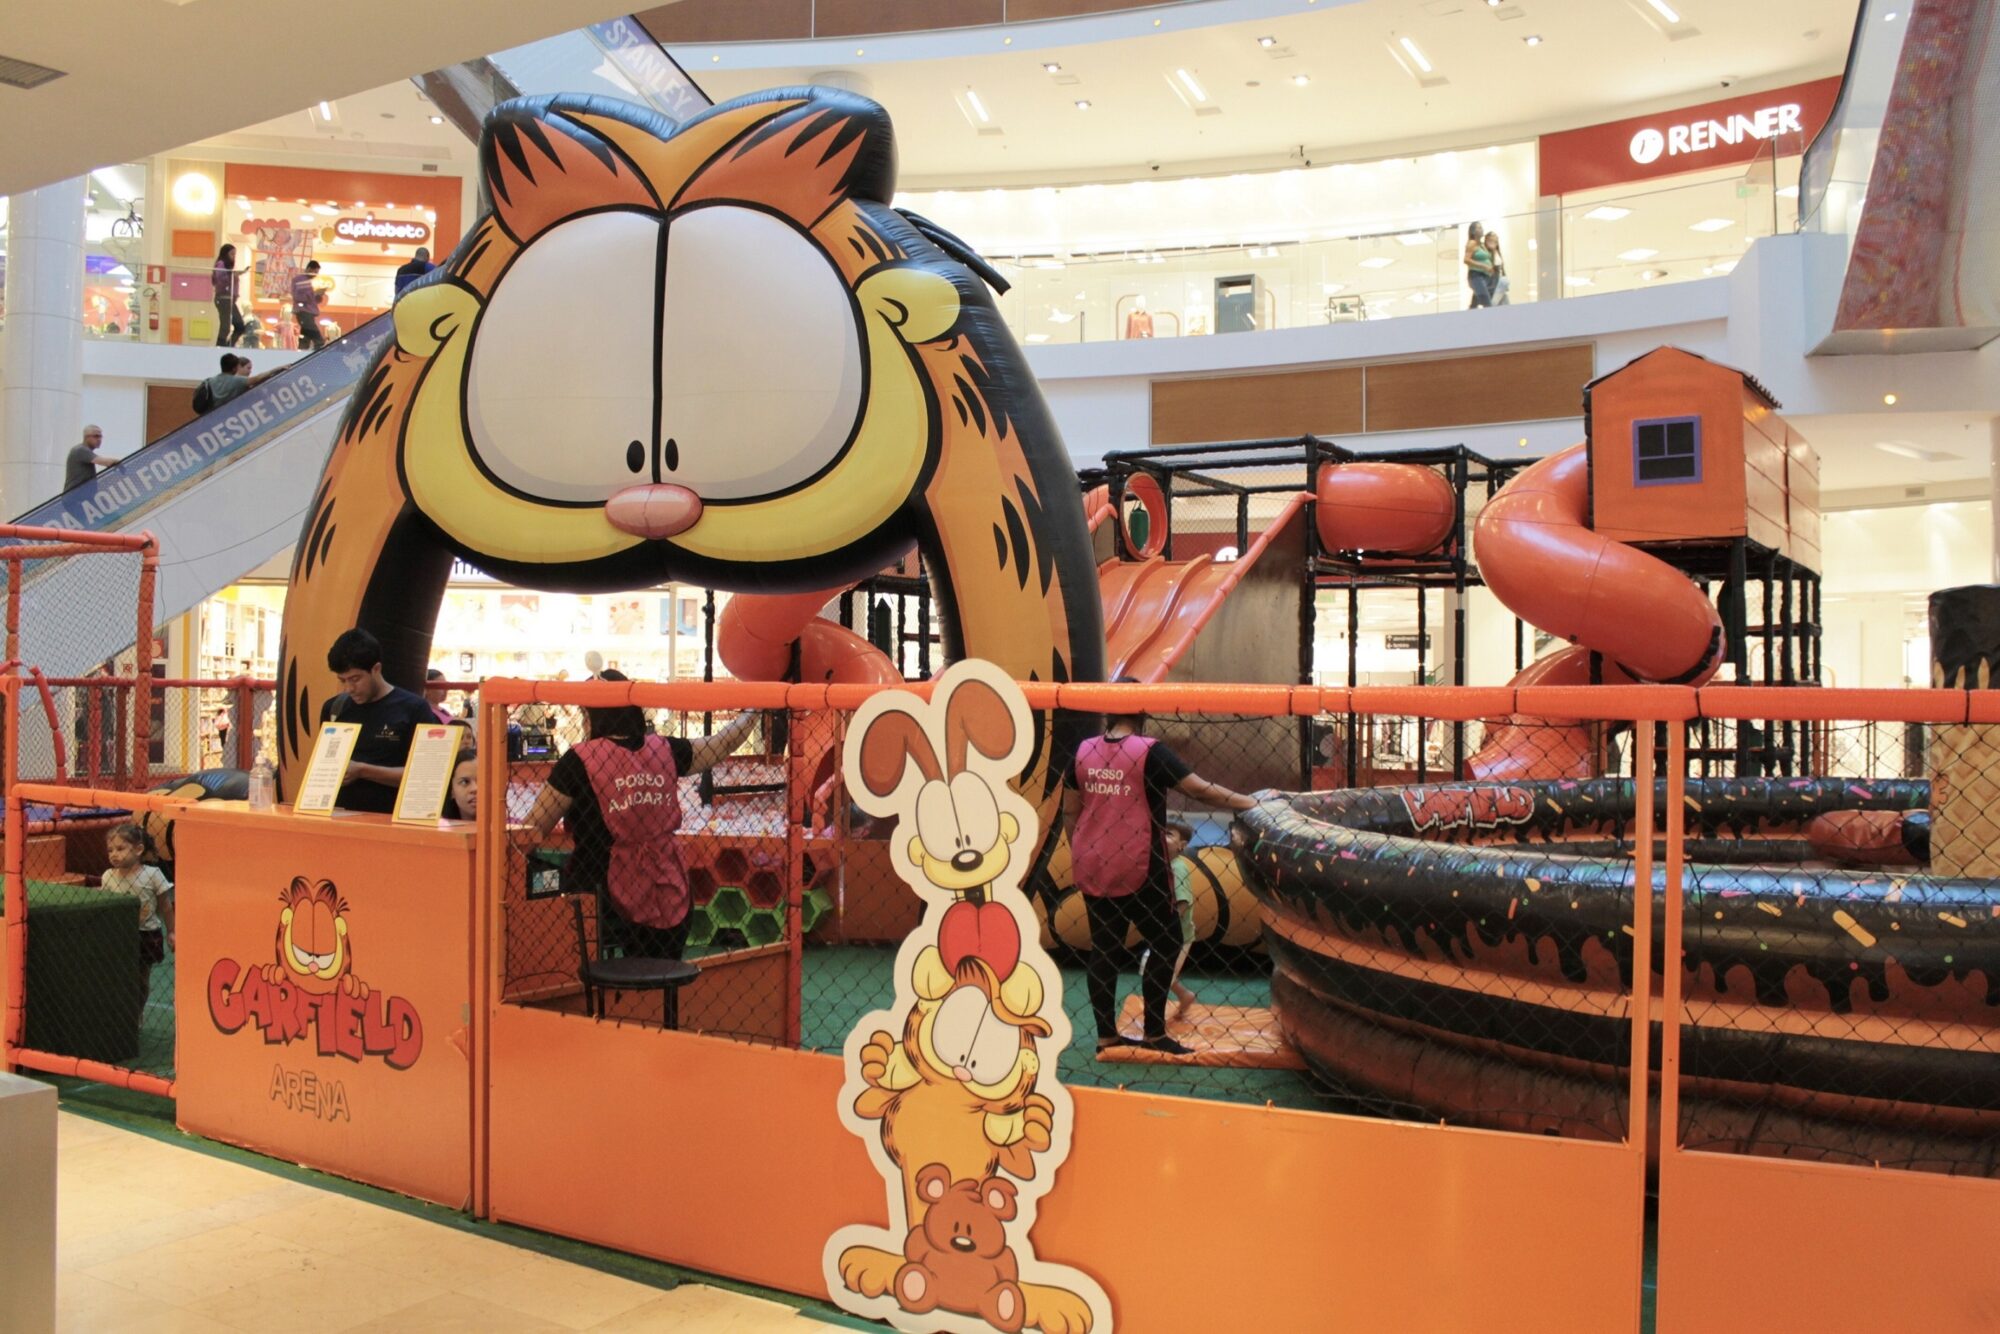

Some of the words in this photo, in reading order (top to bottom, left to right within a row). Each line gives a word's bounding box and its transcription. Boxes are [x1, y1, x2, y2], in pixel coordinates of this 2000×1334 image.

[1668, 104, 1802, 156] RENNER
[338, 220, 425, 238] alphabeto
[81, 476, 141, 525] AQUI
[136, 443, 202, 491] FORA
[196, 402, 274, 456] DESDE
[207, 957, 423, 1071] GARFIELD
[269, 1063, 350, 1122] ARENA
